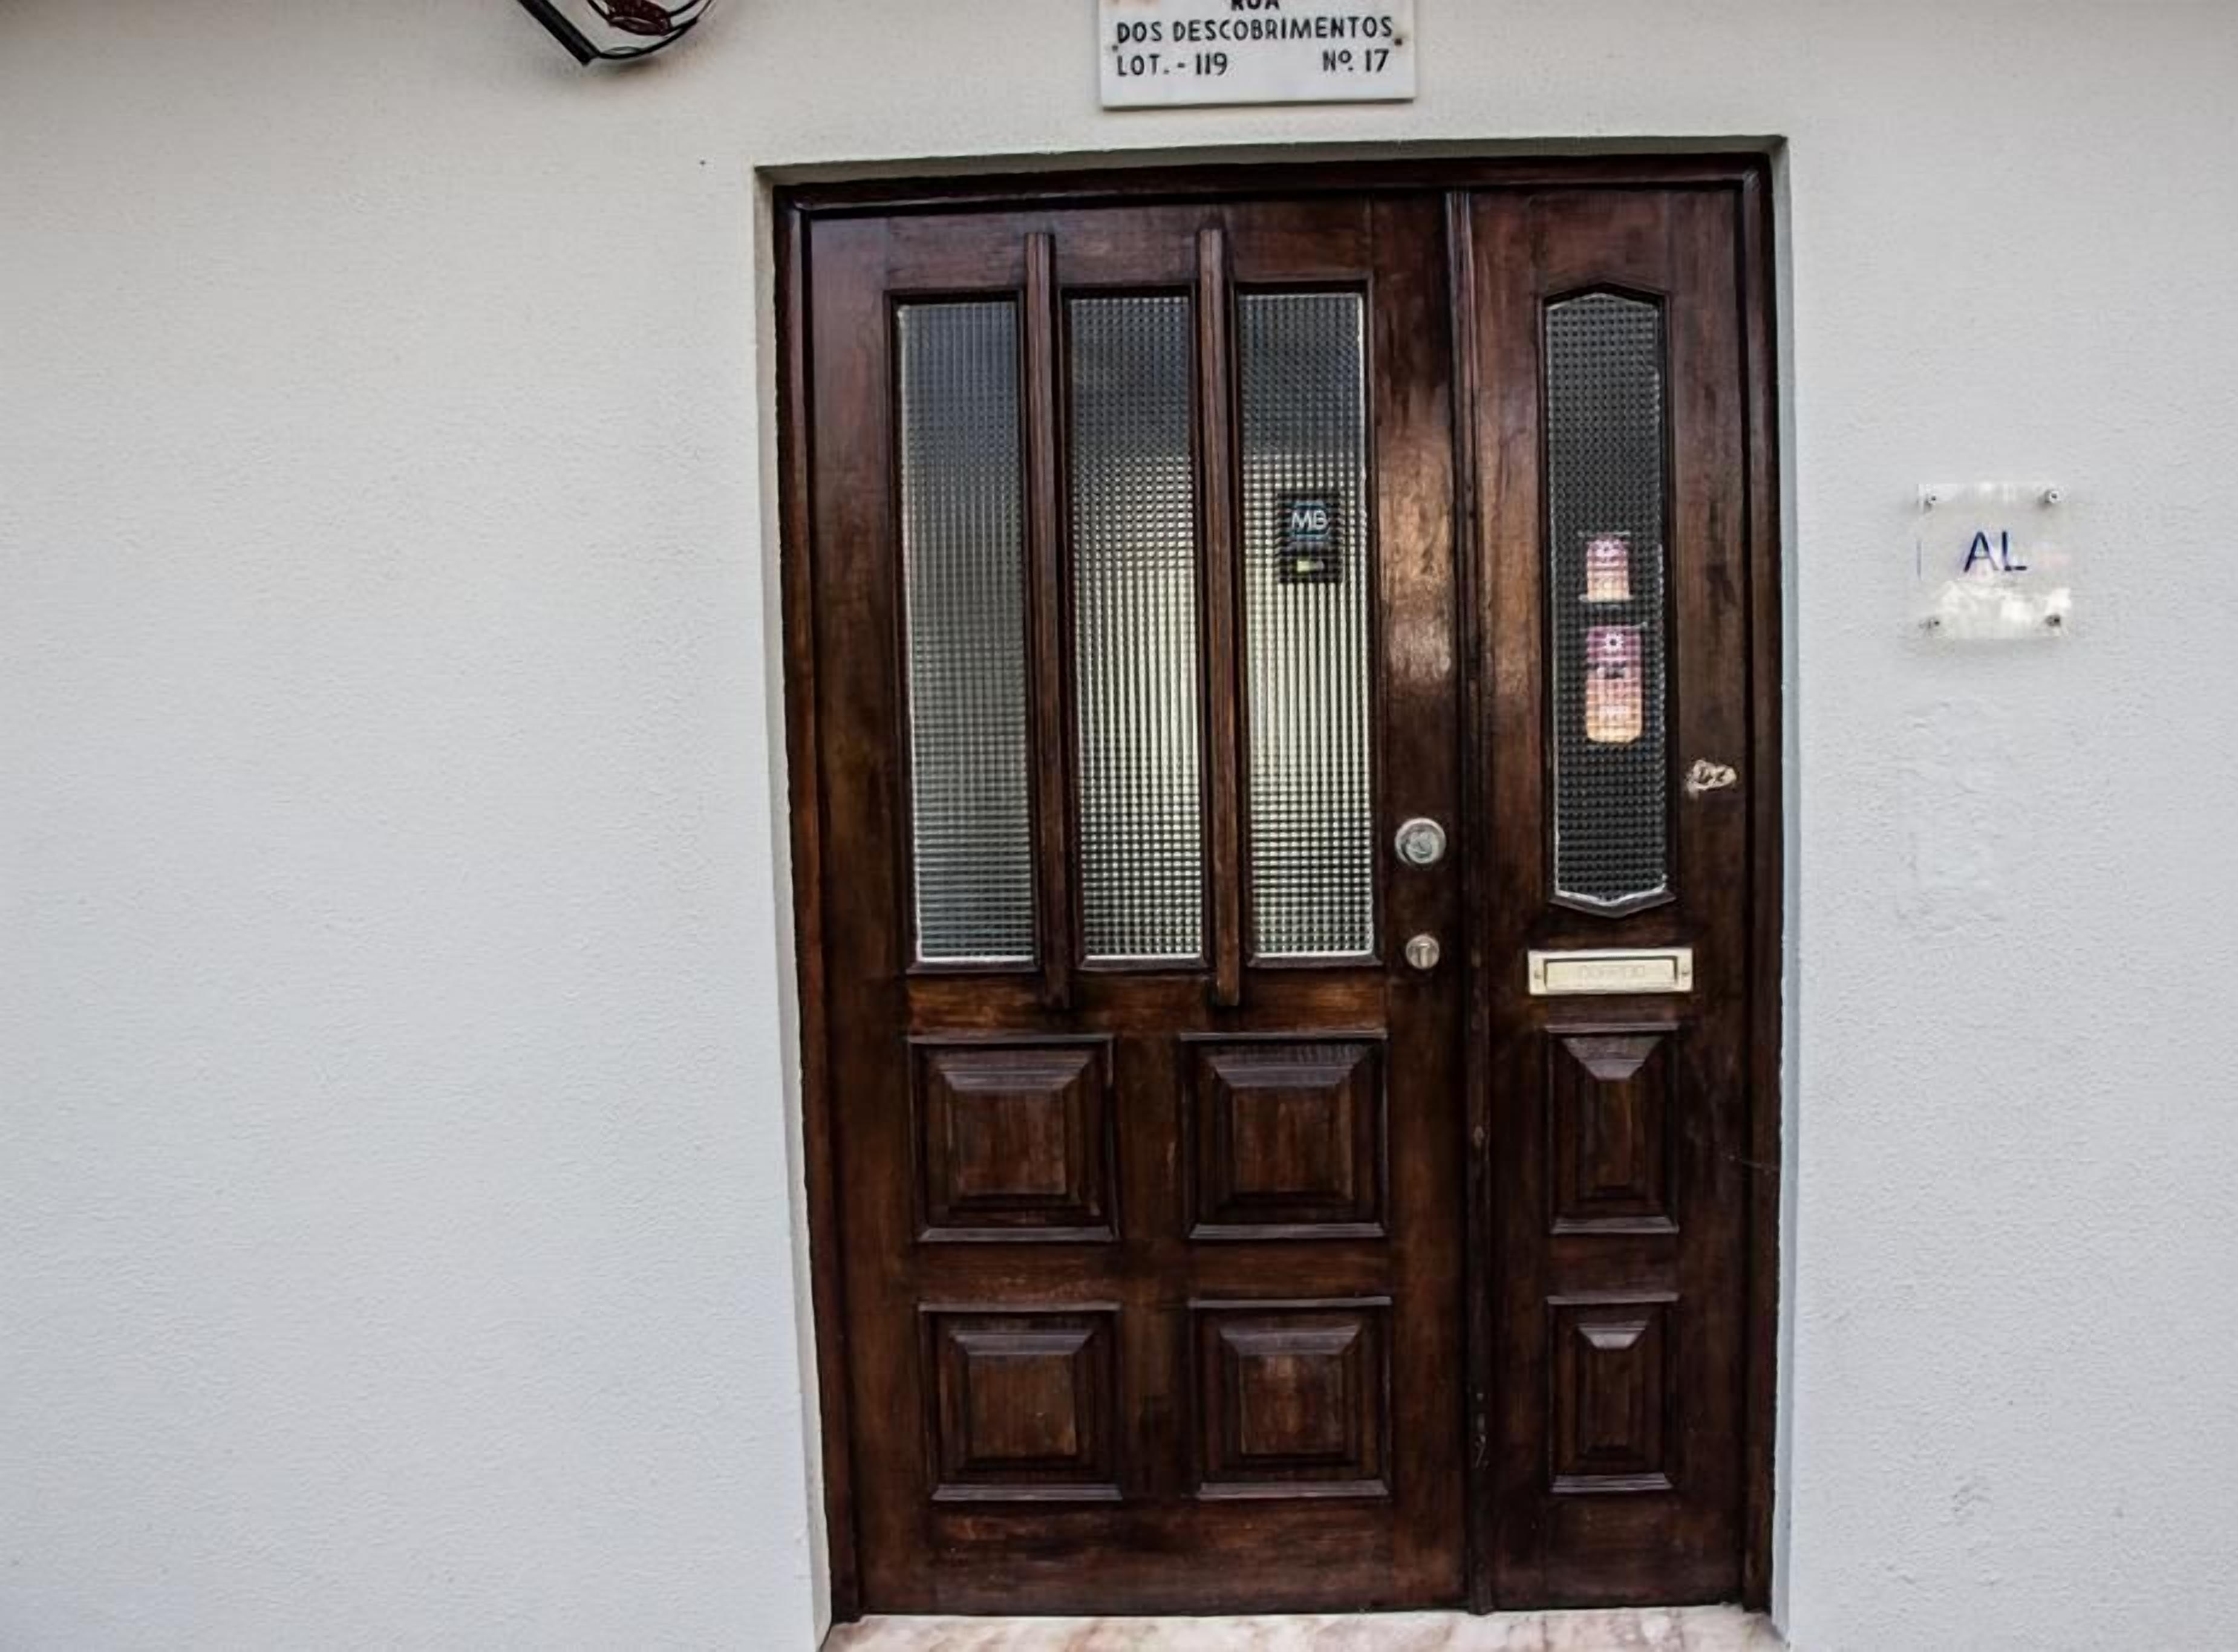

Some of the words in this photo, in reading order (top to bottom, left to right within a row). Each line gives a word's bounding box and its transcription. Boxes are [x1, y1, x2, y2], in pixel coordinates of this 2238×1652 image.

[1117, 21, 1163, 44] DOS
[1173, 16, 1393, 42] DESCOBRIMENTOS
[1195, 52, 1228, 76] 119
[1365, 48, 1389, 72] 17
[1292, 509, 1329, 530] MB
[1963, 530, 2028, 573] AL
